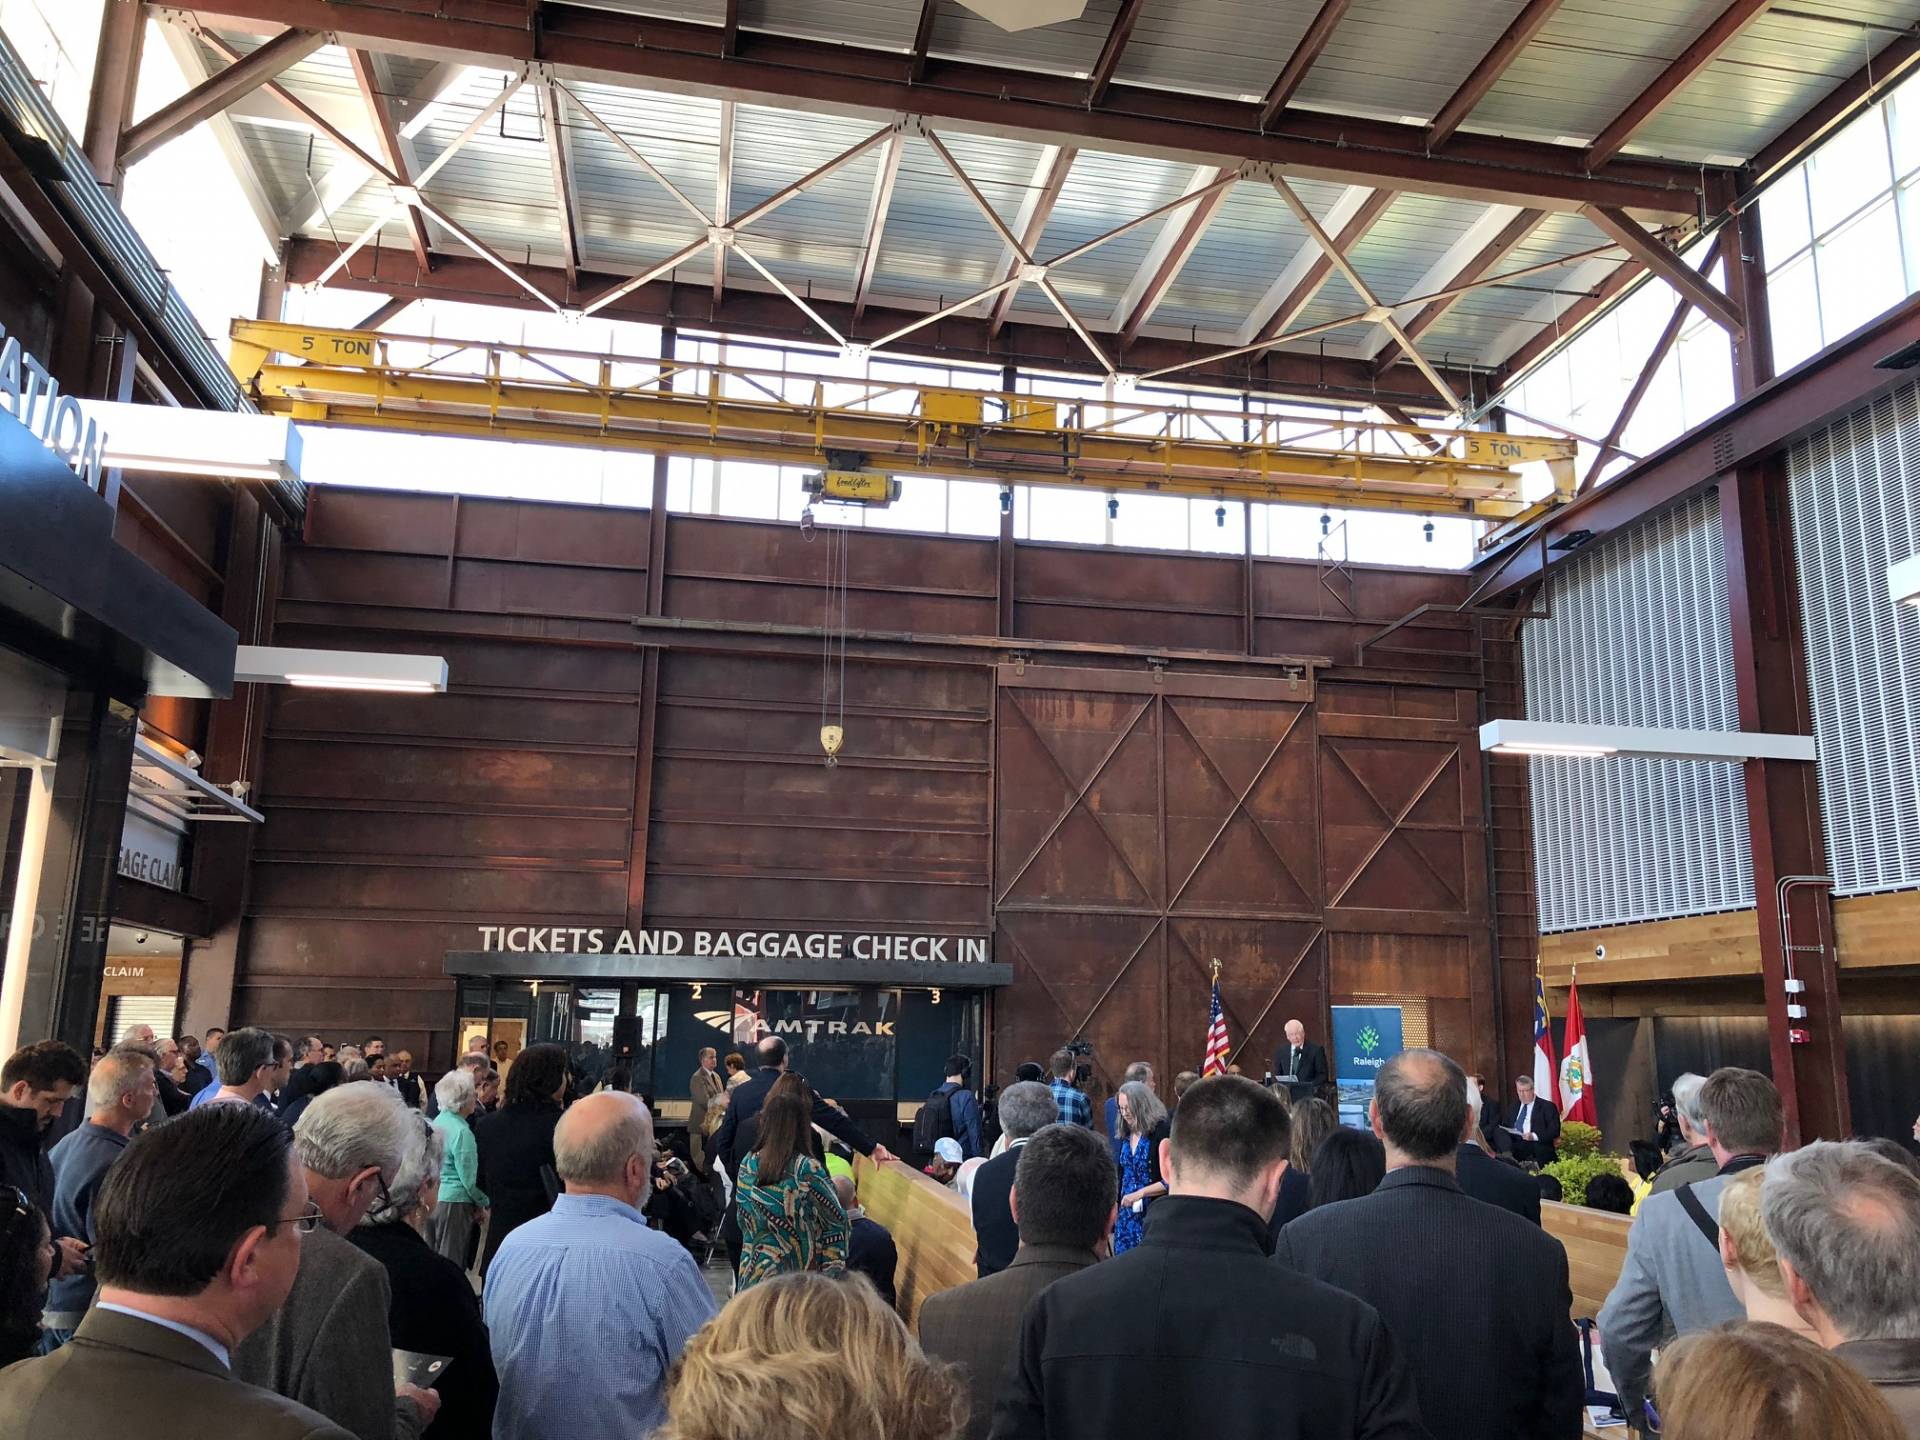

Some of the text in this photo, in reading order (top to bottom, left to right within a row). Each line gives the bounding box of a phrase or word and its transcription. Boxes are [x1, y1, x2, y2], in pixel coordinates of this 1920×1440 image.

[301, 336, 371, 356] 5 TON
[0, 322, 109, 492] ATION
[1470, 441, 1521, 457] 5 TON
[478, 926, 985, 963] TICKETS AND BAGGAGE CHECK IN
[103, 966, 144, 977] CLAIM
[530, 982, 538, 997] 1
[691, 984, 702, 999] 2
[931, 988, 941, 1004] 3
[750, 1019, 896, 1035] AMTRAK
[1353, 1056, 1385, 1069] Raleigh
